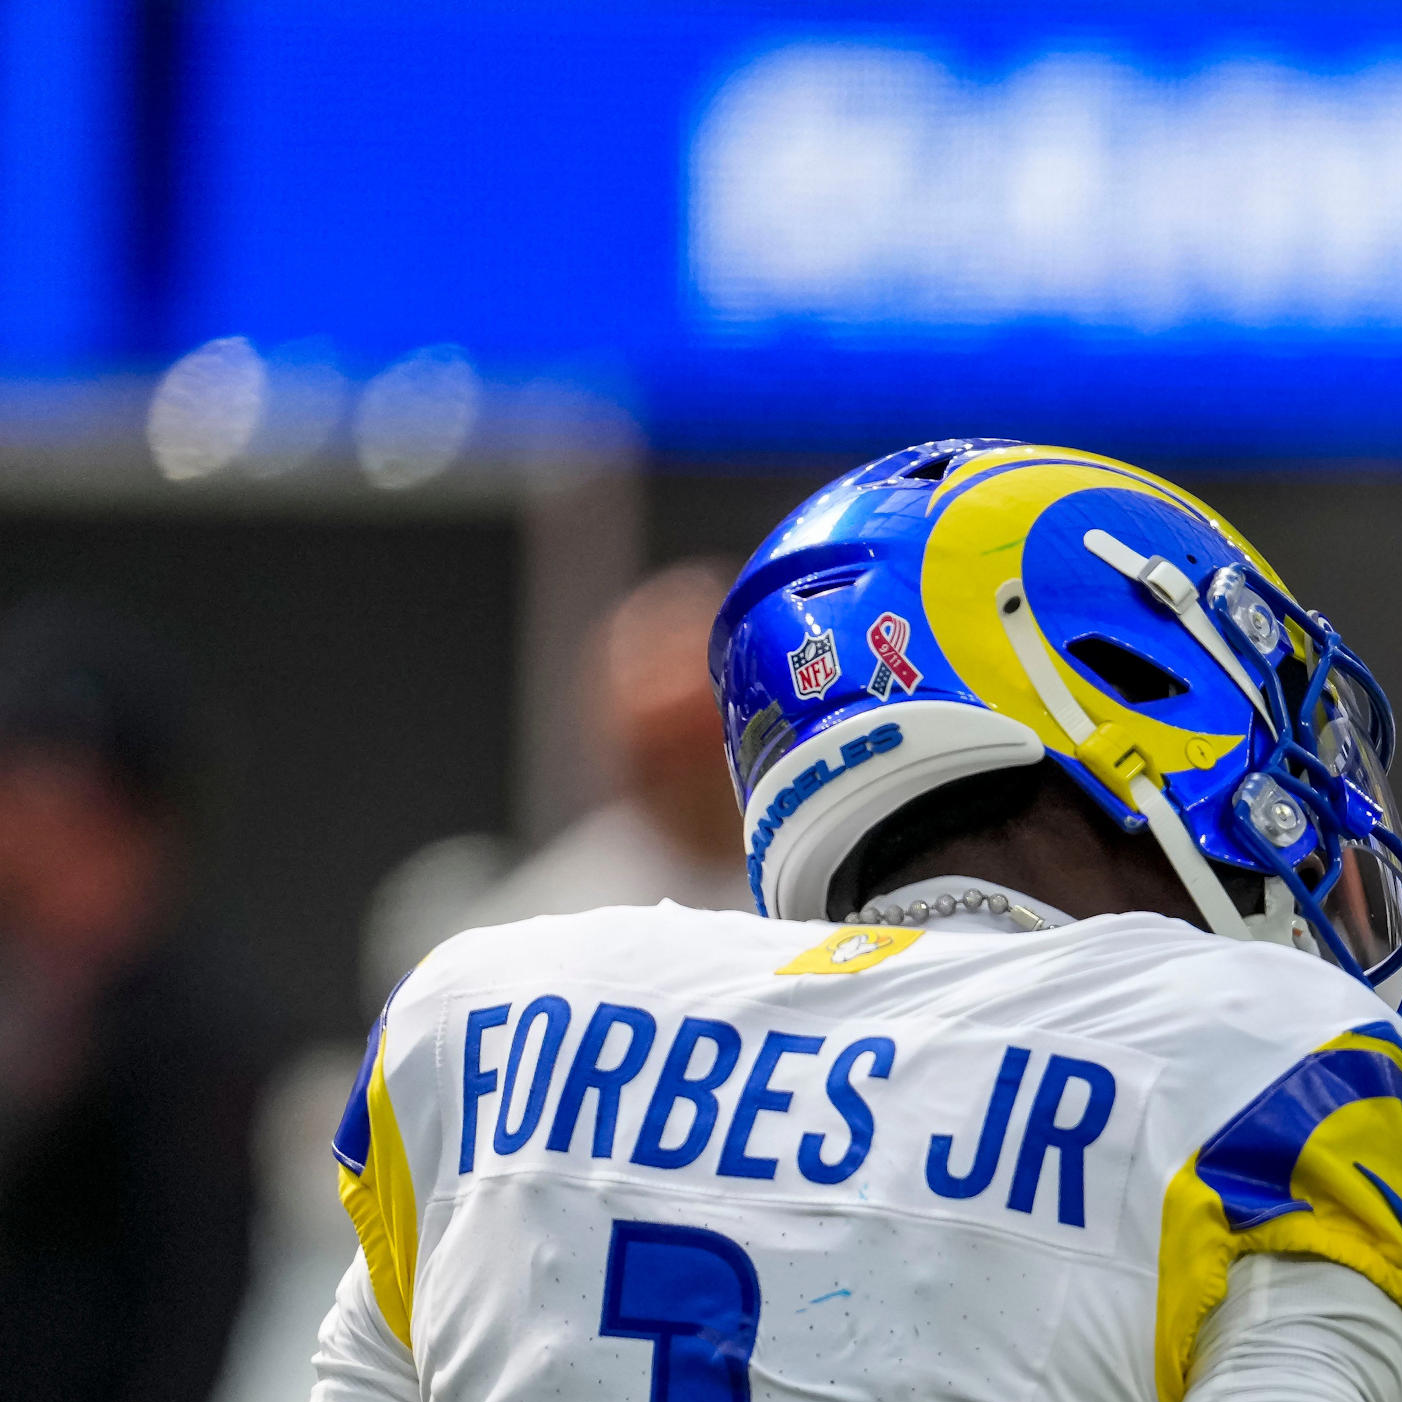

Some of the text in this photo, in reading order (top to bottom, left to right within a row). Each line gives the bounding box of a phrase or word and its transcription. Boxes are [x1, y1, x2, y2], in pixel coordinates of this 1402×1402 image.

[797, 656, 834, 691] NFL
[878, 643, 903, 669] 9/11
[457, 993, 1116, 1229] FORBES JR
